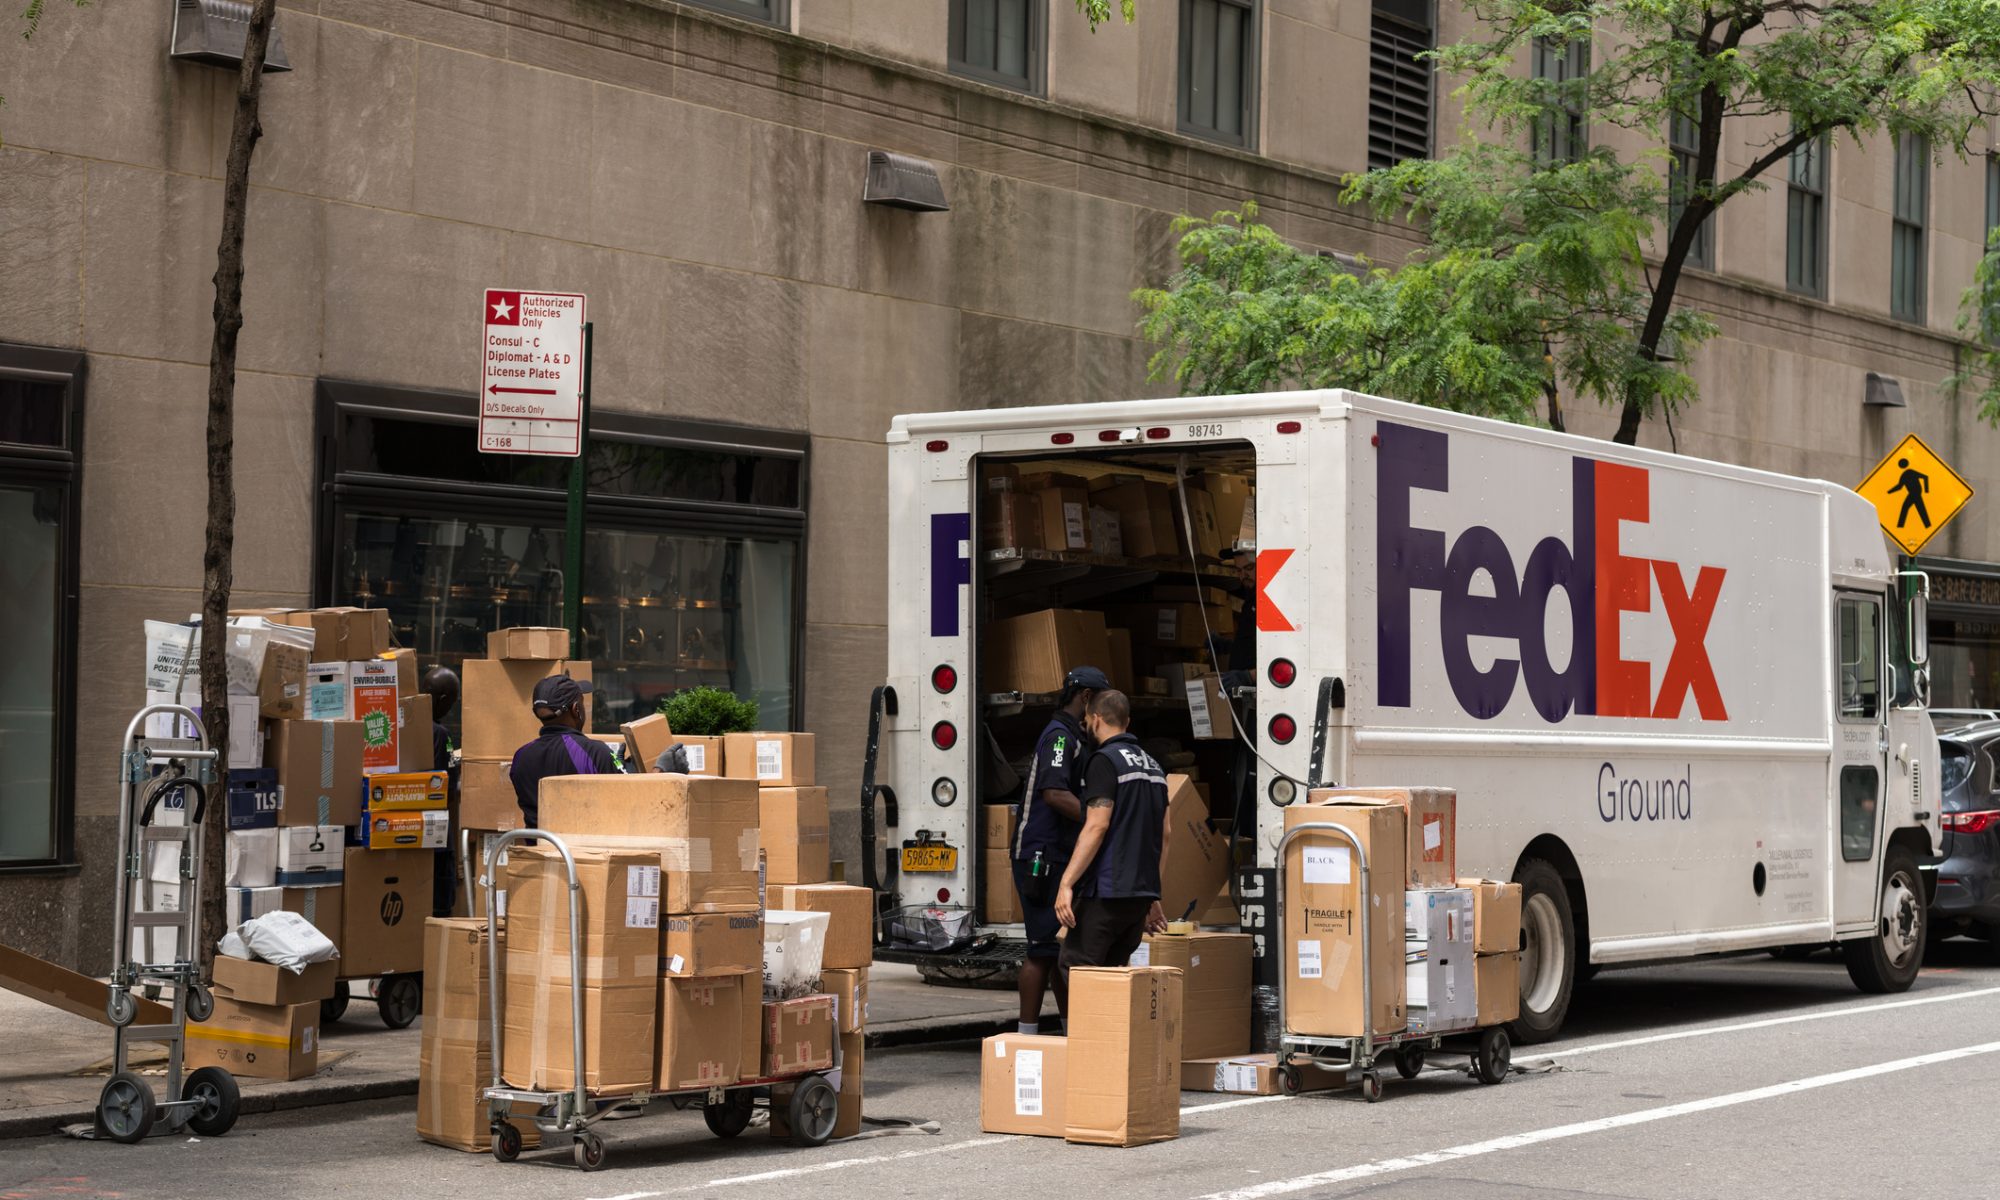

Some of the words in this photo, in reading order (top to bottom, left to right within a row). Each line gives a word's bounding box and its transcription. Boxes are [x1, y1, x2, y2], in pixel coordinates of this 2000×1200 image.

[523, 296, 574, 308] Authorized
[522, 308, 561, 318] Vehicles
[522, 318, 543, 329] Only
[489, 335, 523, 347] Consul
[533, 337, 540, 348] C
[488, 351, 534, 364] Diplomat
[543, 354, 551, 364] A
[553, 354, 561, 364] &
[564, 354, 571, 364] D
[488, 366, 526, 378] License
[529, 368, 561, 379] Plates
[486, 404, 500, 413] D/S
[501, 405, 526, 414] Decals
[528, 406, 545, 416] Only
[1188, 424, 1223, 438] 98743
[486, 436, 512, 447] C-168
[1377, 420, 1729, 723] FedEx
[1945, 577, 1967, 601] BAR
[367, 717, 385, 728] VALUE
[369, 728, 384, 738] PACK
[1051, 736, 1066, 767] FedEx
[1598, 762, 1691, 822] Ground
[255, 792, 277, 810] TLS
[1307, 856, 1335, 865] BLACK
[381, 890, 404, 927] hp
[1310, 909, 1345, 918] FRAGILE
[1150, 989, 1158, 1020] BOX
